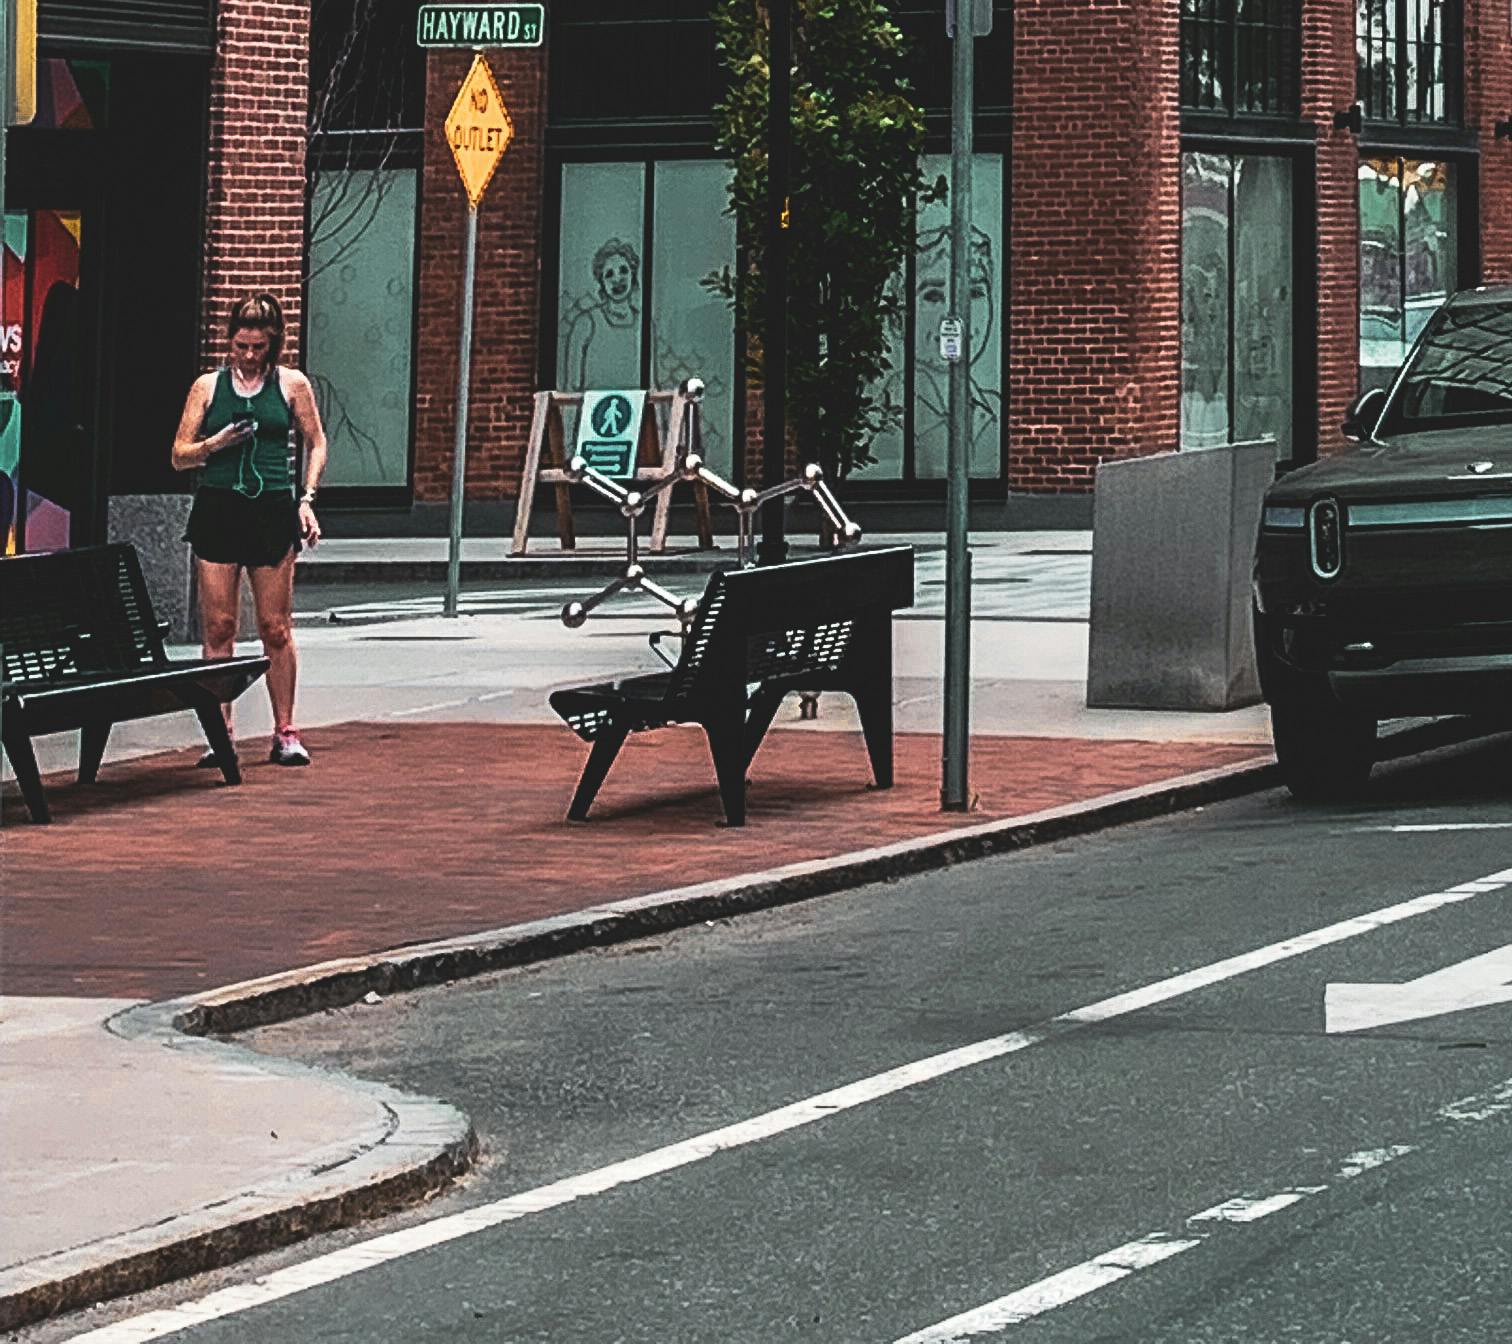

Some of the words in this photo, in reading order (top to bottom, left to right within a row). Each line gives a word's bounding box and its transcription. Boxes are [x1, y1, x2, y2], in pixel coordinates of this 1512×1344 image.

[423, 10, 521, 41] HAYWARD
[523, 23, 537, 41] ST
[453, 124, 503, 152] OUTLET
